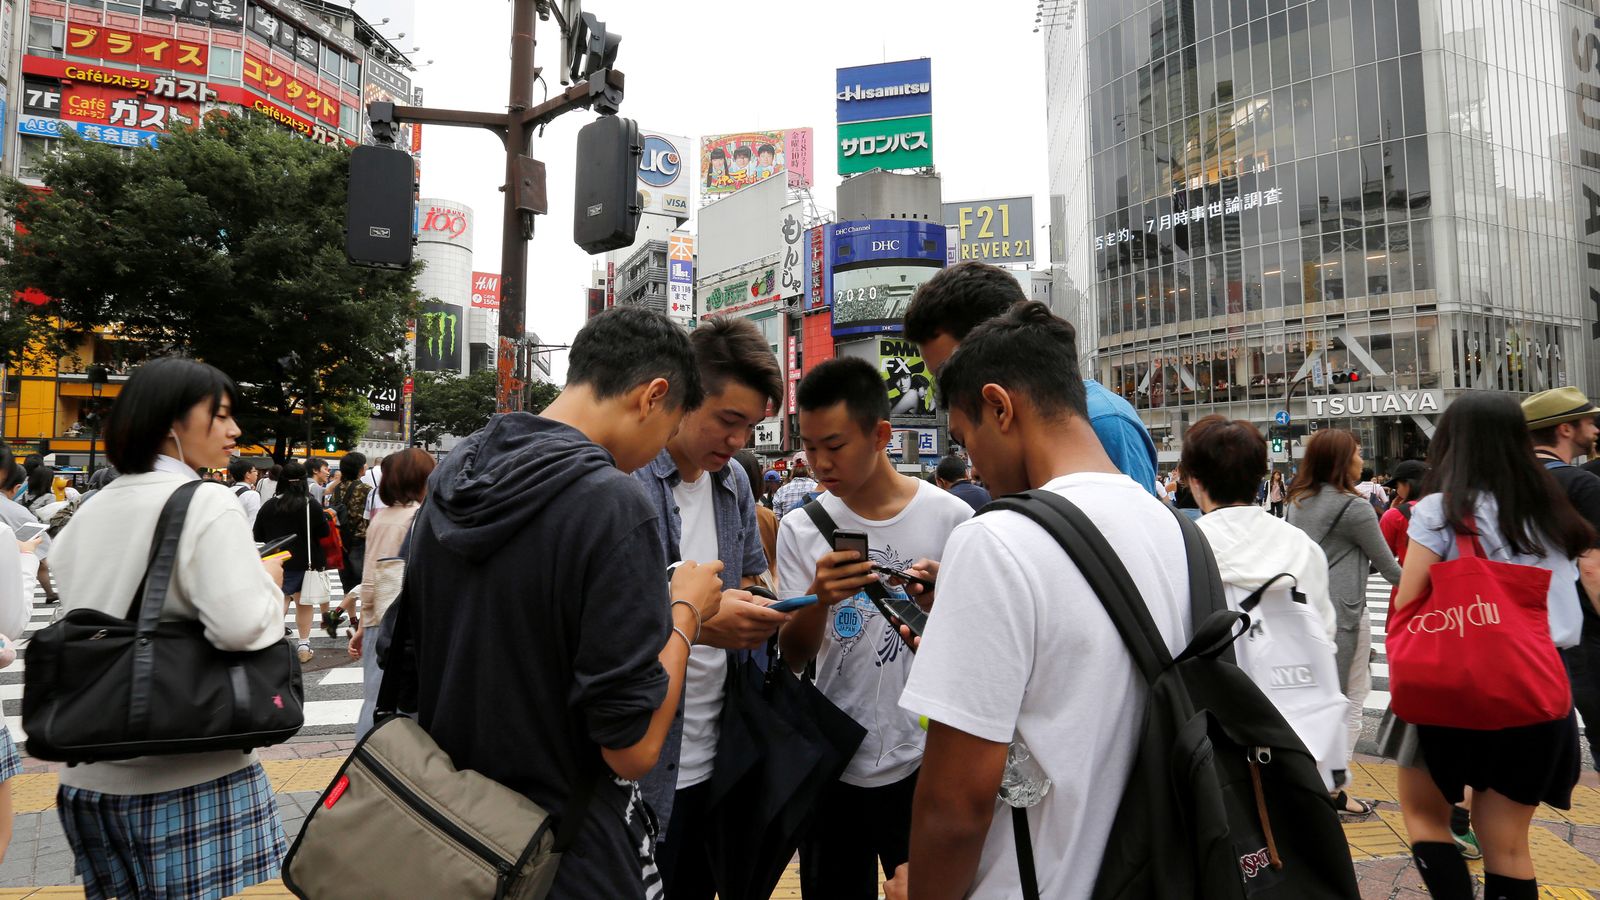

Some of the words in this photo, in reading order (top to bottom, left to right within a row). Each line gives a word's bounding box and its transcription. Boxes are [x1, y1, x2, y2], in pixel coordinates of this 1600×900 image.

[70, 27, 203, 67] プライス
[154, 76, 217, 101] ガスト
[244, 57, 336, 117] コンタクト
[837, 82, 931, 101] Hisamitsu
[27, 89, 60, 109] 7F
[69, 95, 106, 111] Café
[110, 99, 192, 130] ガスト
[841, 129, 928, 156] サロンパス
[431, 206, 466, 217] SHIBUYA
[666, 198, 687, 209] VISA
[420, 210, 467, 239] 109
[836, 227, 848, 236] DHC
[848, 224, 871, 233] Channel
[959, 205, 1010, 241] F21
[670, 237, 693, 261] 本
[782, 213, 802, 293] もんじゃ
[872, 239, 901, 251] DHC
[962, 241, 1011, 260] REVER
[1014, 239, 1032, 257] 21
[475, 276, 498, 292] H&M
[837, 286, 877, 304] 2020
[881, 357, 912, 374] FX
[1311, 391, 1439, 416] TSUTAYA
[1271, 666, 1313, 686] NYC
